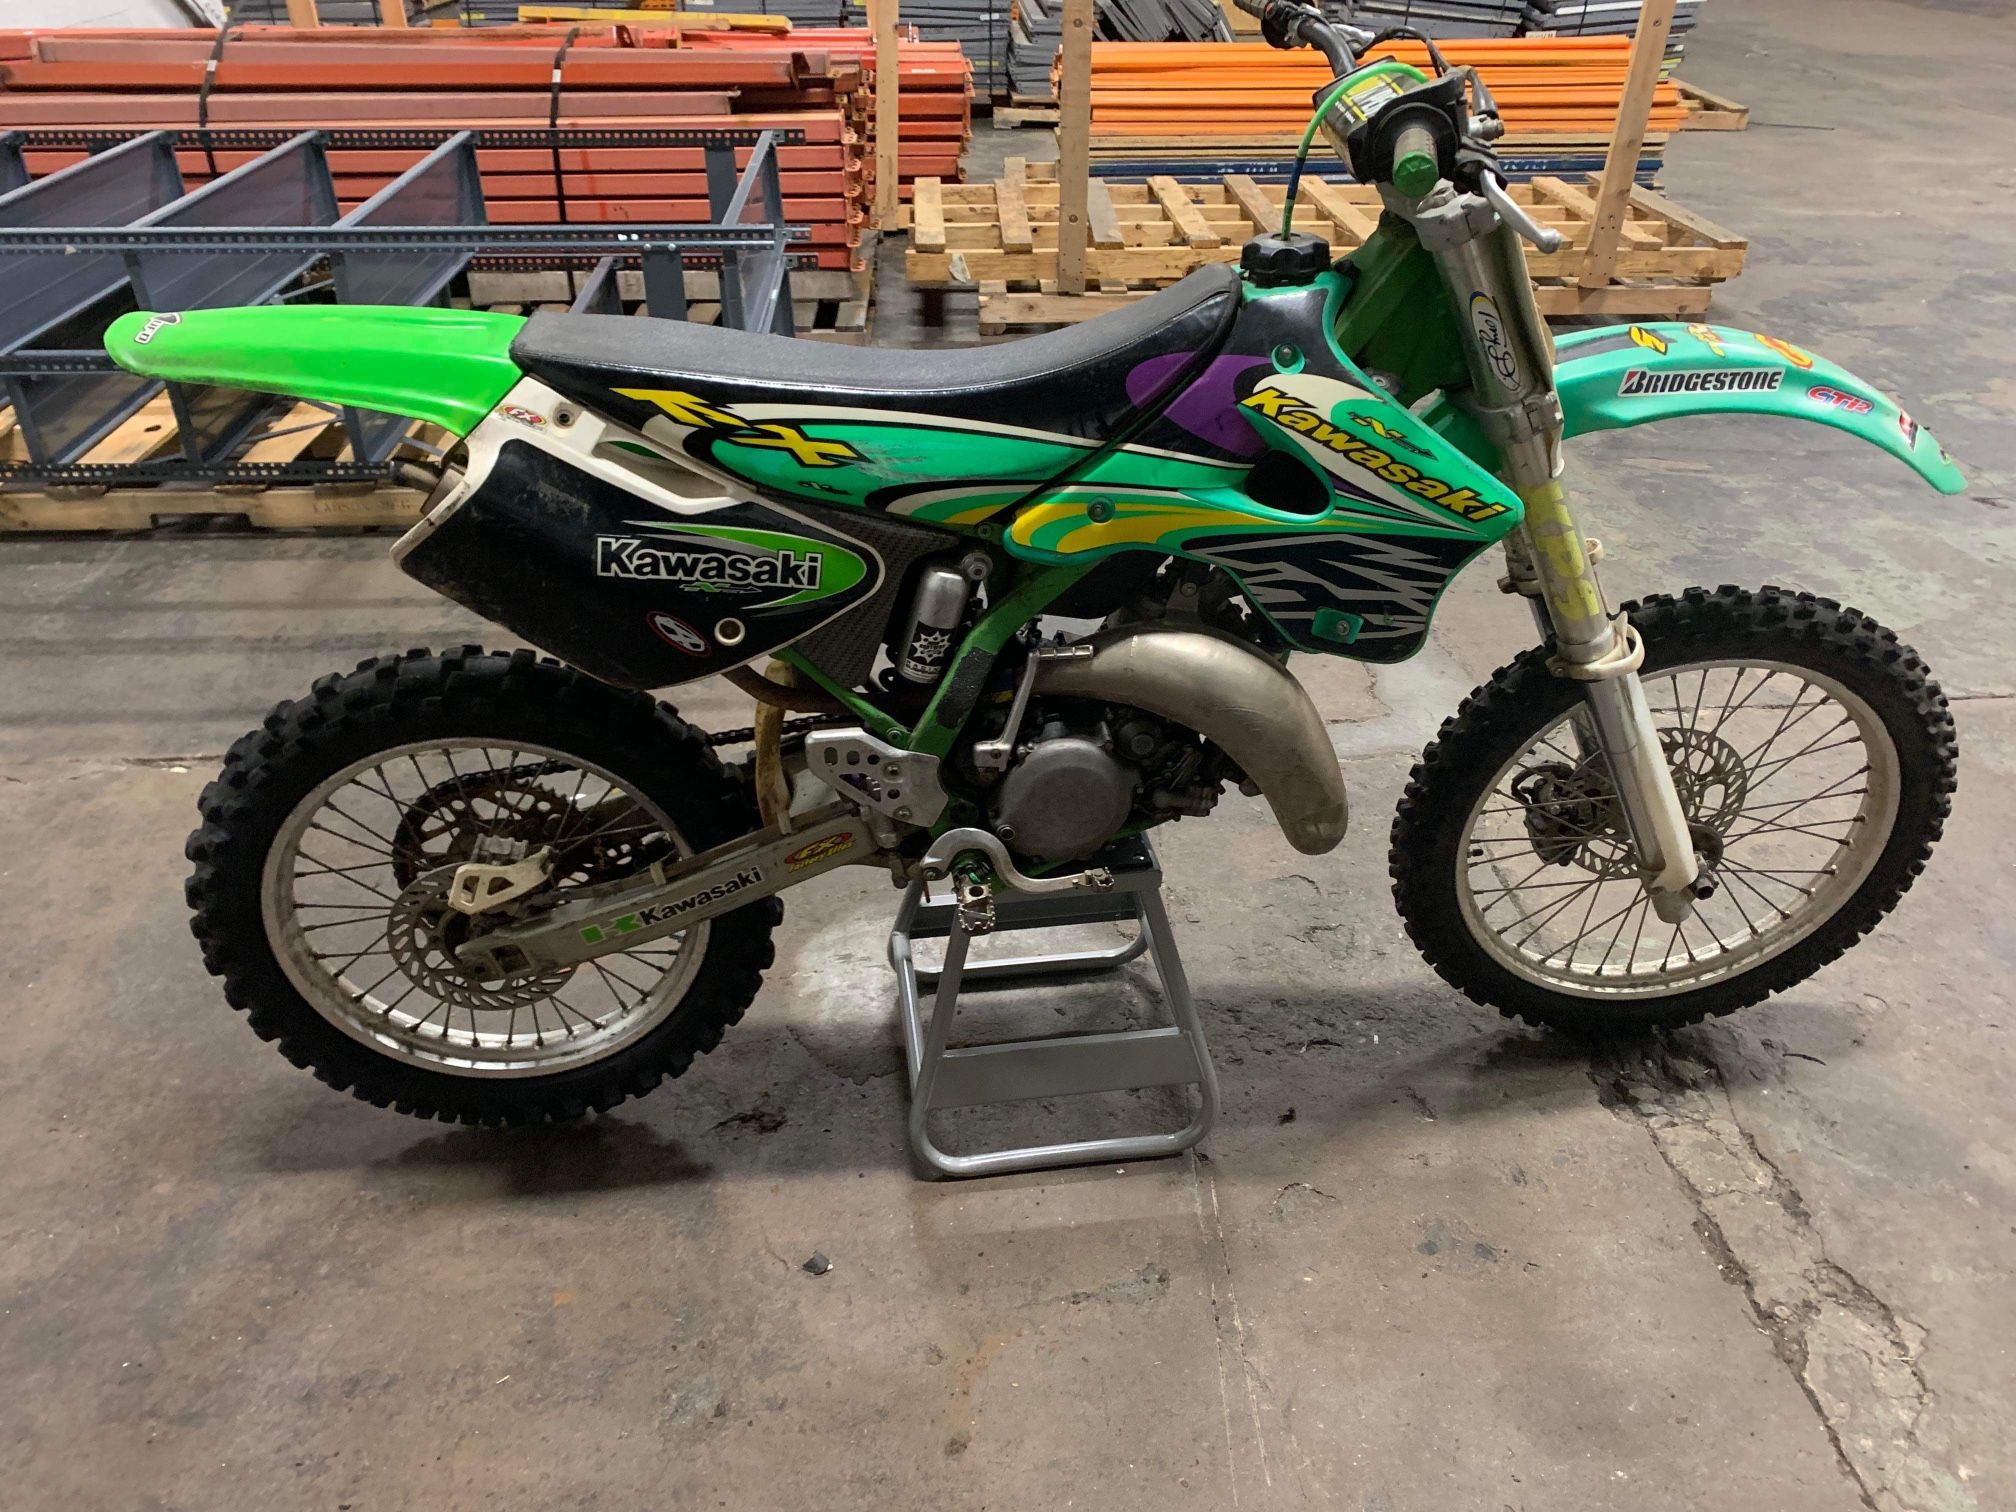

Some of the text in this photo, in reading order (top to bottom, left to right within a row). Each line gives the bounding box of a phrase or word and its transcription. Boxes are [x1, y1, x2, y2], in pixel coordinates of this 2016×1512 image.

[1622, 370, 1783, 394] BRIDGESTONE
[1239, 386, 1514, 523] Kawasaki
[596, 534, 823, 591] Kawasaki
[639, 866, 763, 926] Kawasaki
